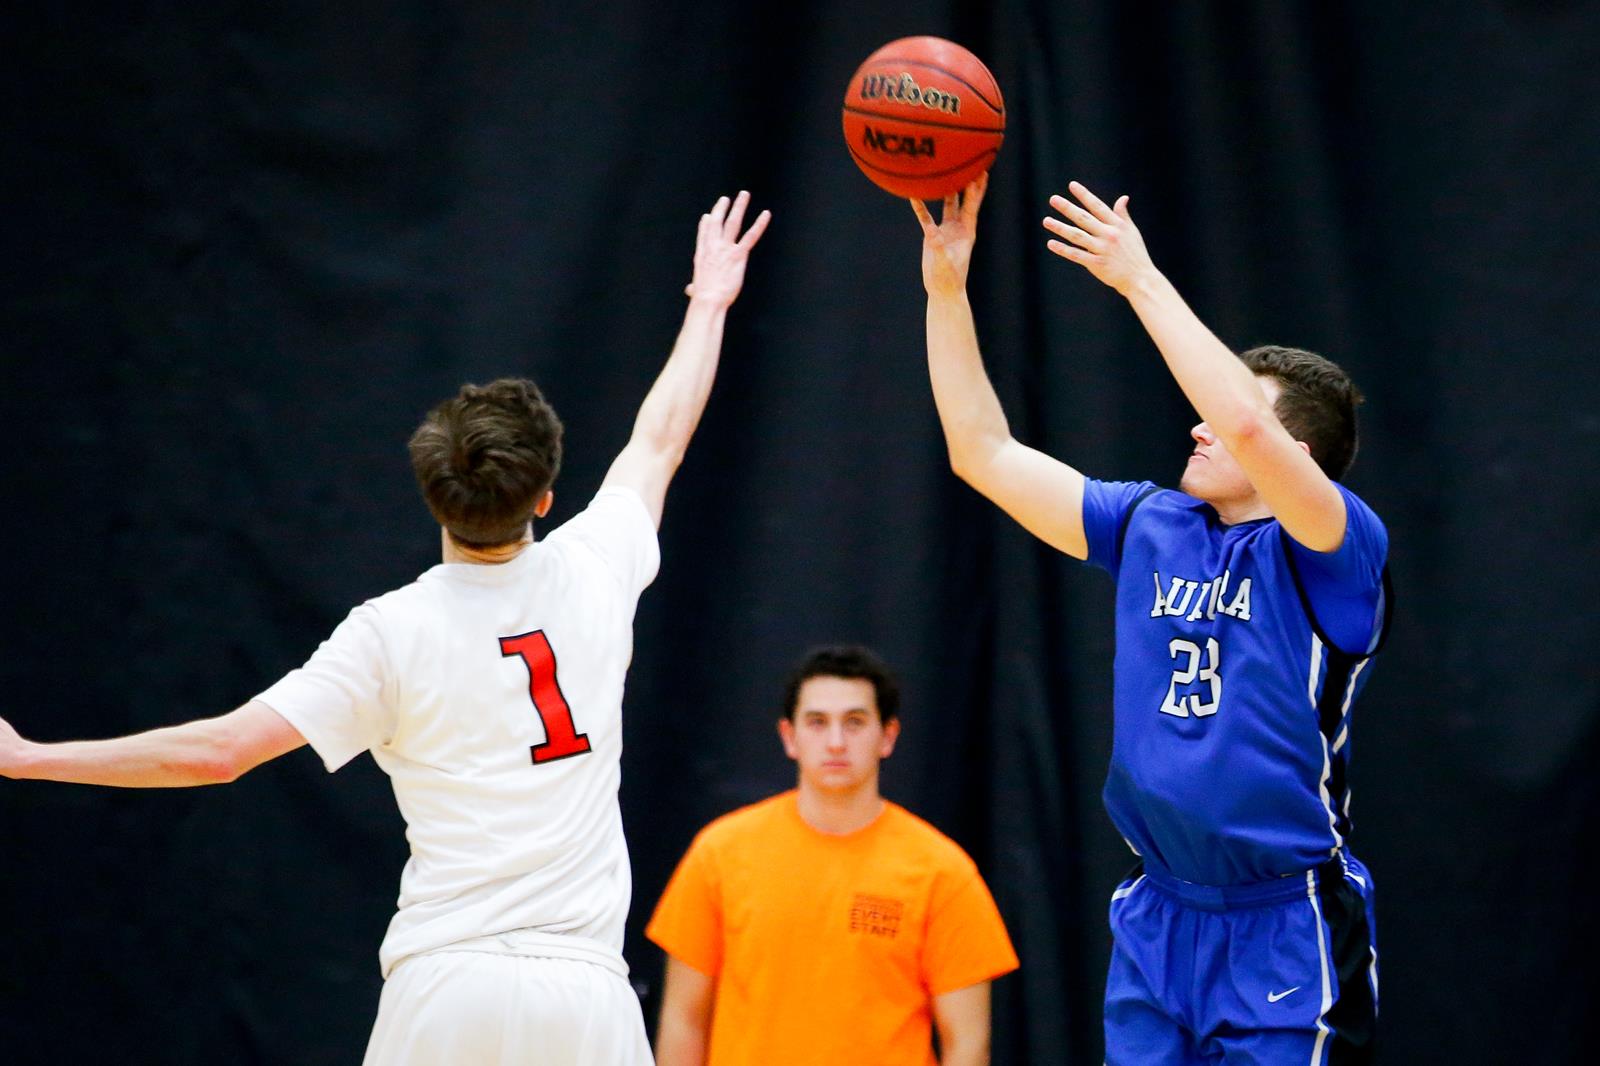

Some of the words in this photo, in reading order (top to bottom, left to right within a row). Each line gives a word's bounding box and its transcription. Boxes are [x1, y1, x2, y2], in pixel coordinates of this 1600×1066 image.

[861, 72, 961, 117] Wilson
[864, 126, 936, 159] NCAA
[498, 628, 592, 765] 1
[1159, 636, 1222, 718] 23
